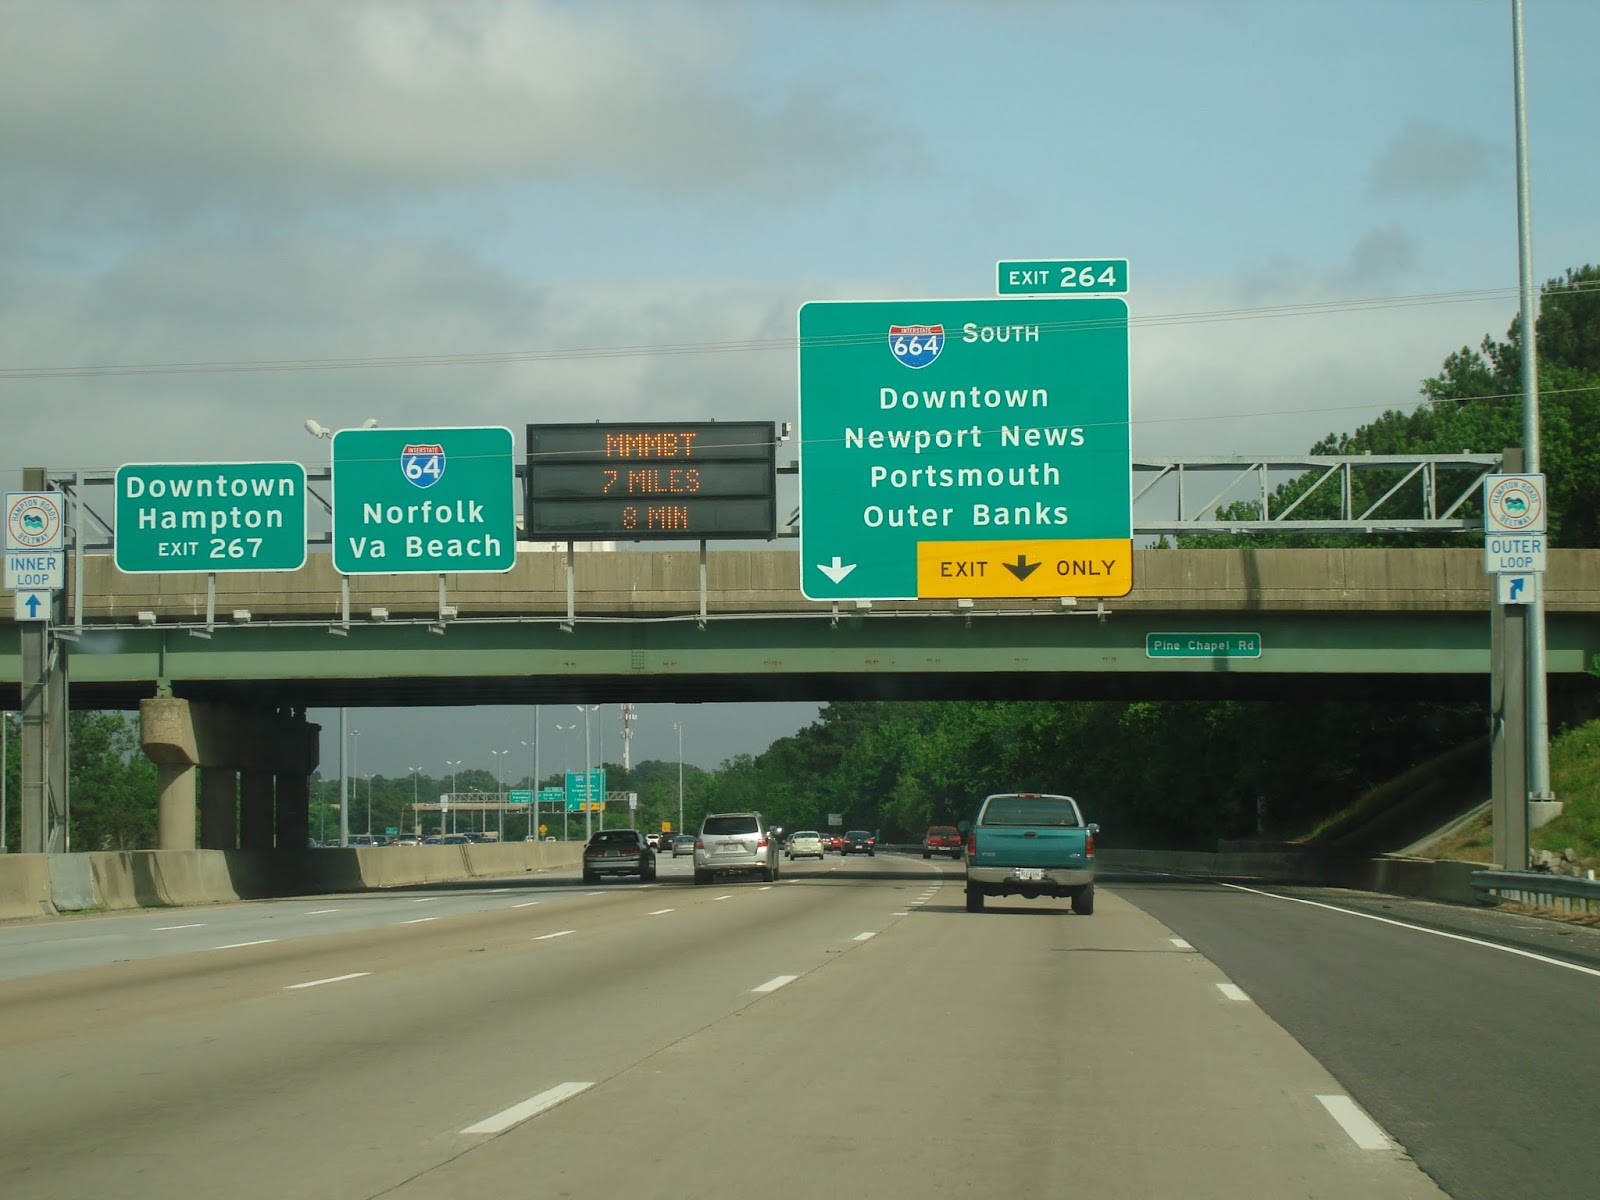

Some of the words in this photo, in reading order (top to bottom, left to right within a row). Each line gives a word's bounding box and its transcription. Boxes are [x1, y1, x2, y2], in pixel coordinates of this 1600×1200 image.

[1009, 271, 1049, 285] EXIT
[1060, 266, 1116, 287] 264
[894, 336, 939, 356] 664
[879, 386, 1048, 410] Downtown
[606, 433, 697, 457] MMMBT
[845, 426, 982, 454] Newport
[1001, 425, 1085, 447] News
[406, 455, 441, 480] 64
[871, 462, 1060, 488] Portsmouth
[126, 475, 295, 499] Downtown
[603, 470, 618, 493] 7
[628, 469, 700, 493] MILES
[1493, 481, 1519, 504] HAMPTON
[1521, 482, 1539, 504] ROADS
[12, 499, 38, 522] HAMPTON
[41, 500, 57, 521] ROADS
[138, 507, 284, 534] Hampton
[363, 500, 485, 525] Norfolk
[623, 506, 637, 529] 8
[648, 506, 688, 529] MIN
[863, 504, 953, 528] Outer
[973, 501, 1069, 526] Banks
[1500, 514, 1532, 528] BELTWAY
[18, 532, 49, 544] BELTWAY
[158, 541, 199, 557] EXIT
[208, 538, 263, 559] 267
[349, 536, 386, 559] Va
[406, 533, 501, 558] Beach
[1491, 540, 1541, 554] OUTER
[11, 557, 56, 571] INNER
[941, 561, 988, 577] EXIT
[1056, 560, 1116, 576] ONLY
[1500, 557, 1533, 568] LOOP
[17, 574, 49, 585] LOOP
[1154, 640, 1180, 651] Pine
[1188, 640, 1230, 652] Chapel
[1238, 640, 1254, 651] Rd
